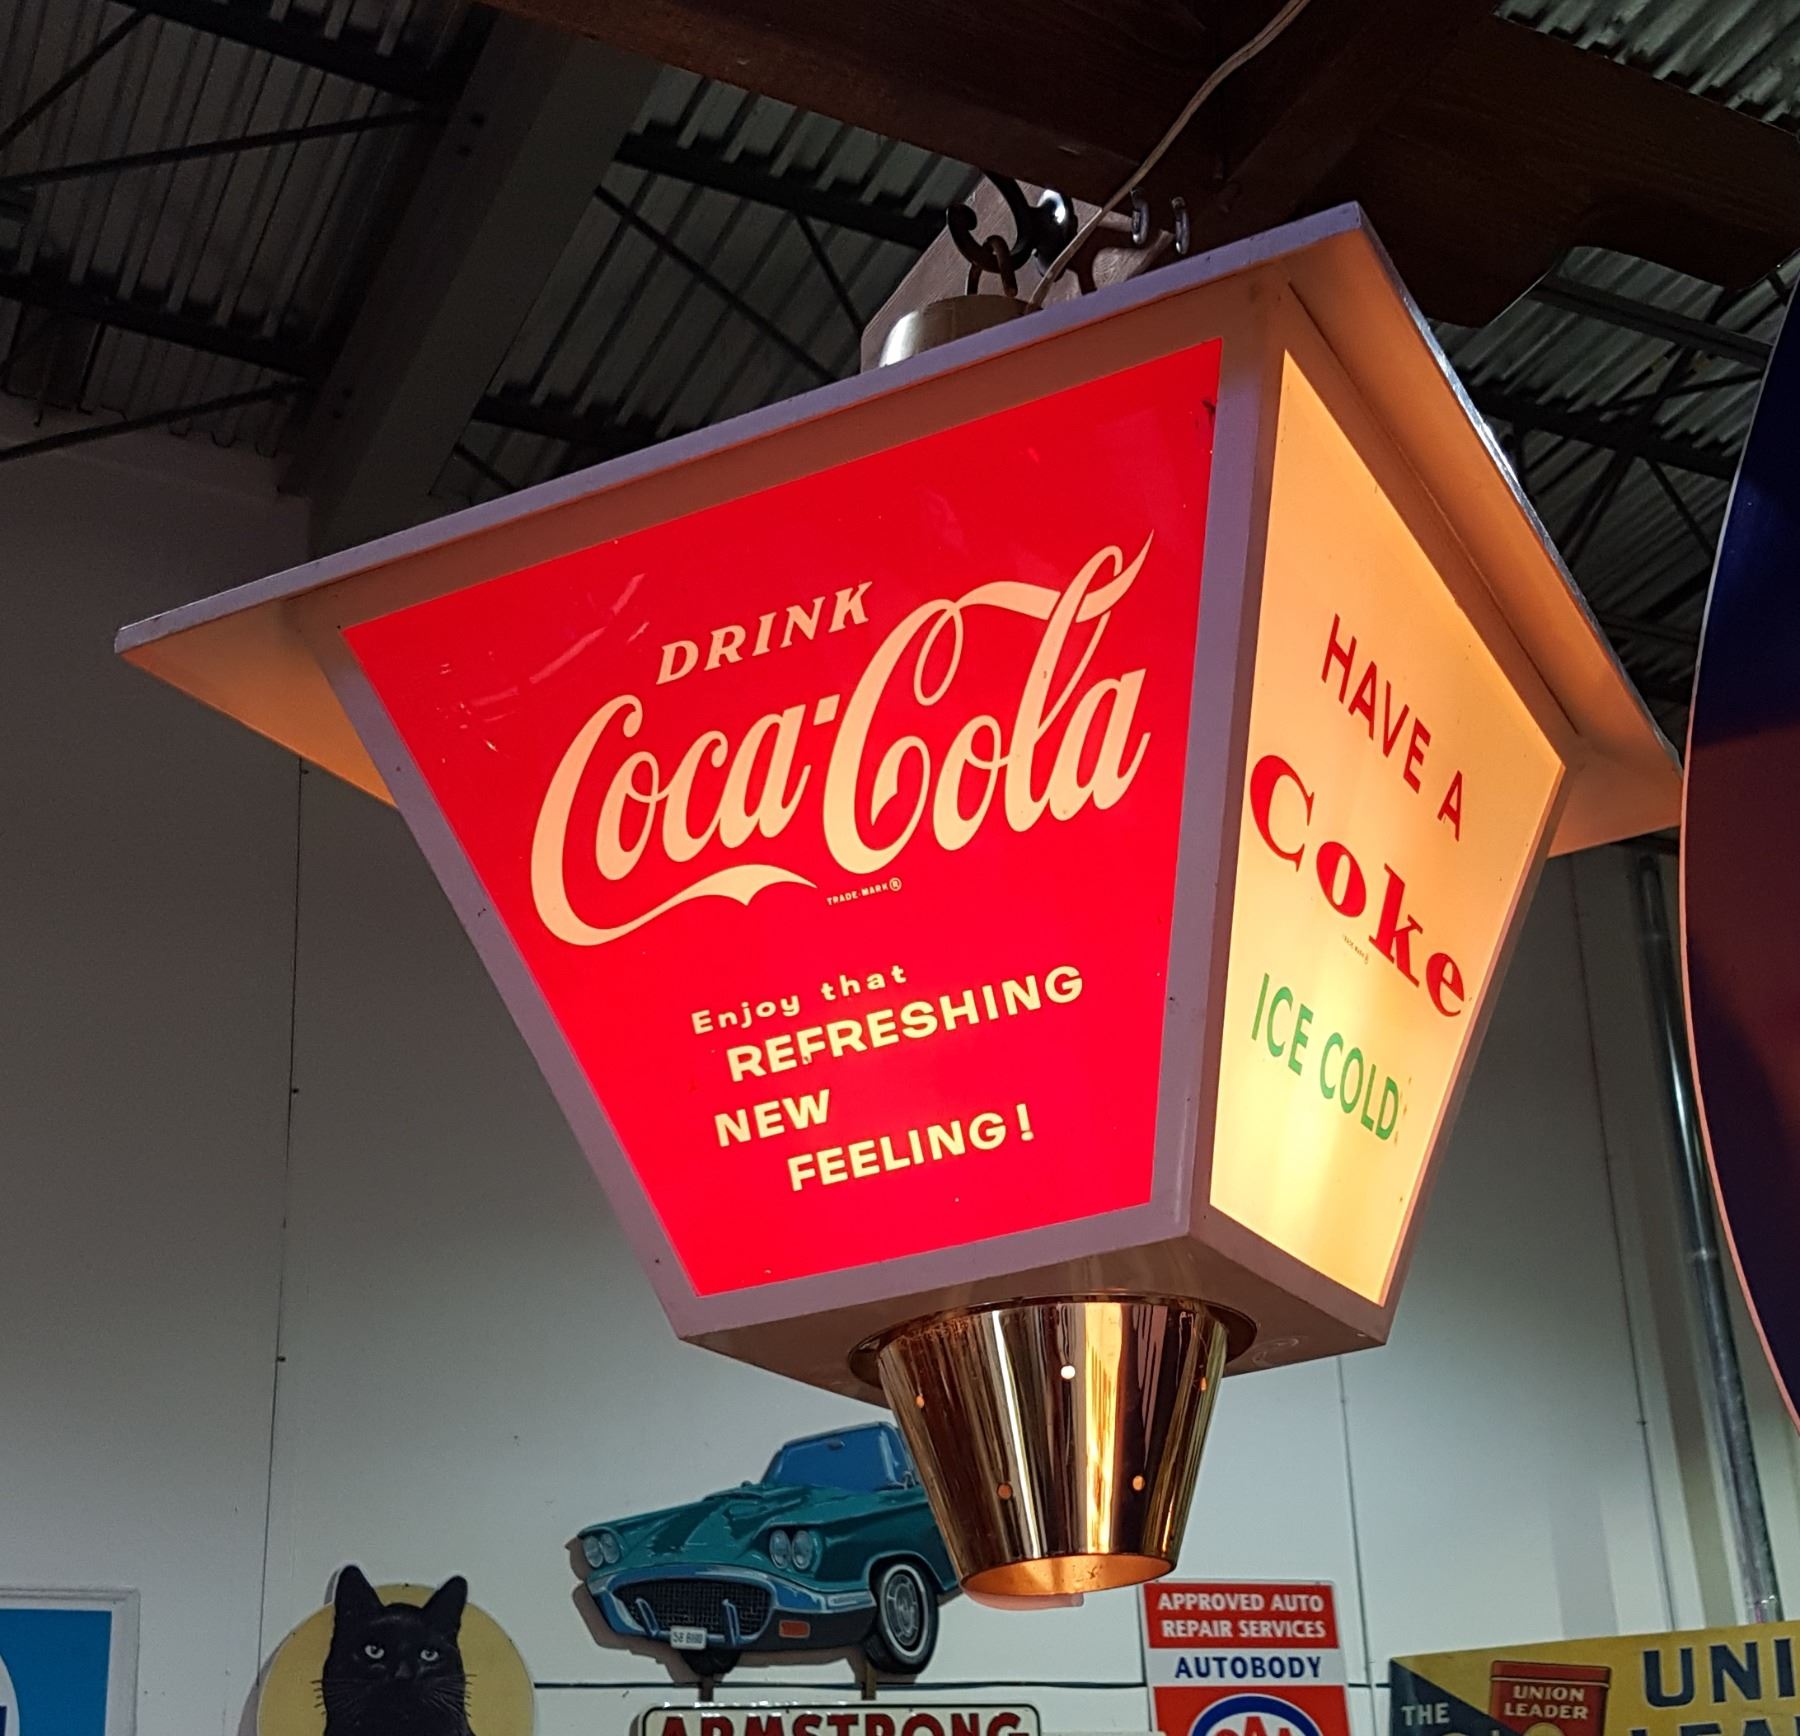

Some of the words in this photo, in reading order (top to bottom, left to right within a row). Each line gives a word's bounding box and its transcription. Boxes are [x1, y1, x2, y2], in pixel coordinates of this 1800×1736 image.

[656, 582, 873, 685] DRINK
[530, 530, 1154, 946] Coca-Cola
[1321, 612, 1431, 795] HAVE
[1437, 770, 1463, 843] A
[1250, 754, 1466, 1017] Coke
[691, 995, 801, 1035] Enjoy
[821, 965, 908, 1001] that
[726, 965, 1083, 1083] REFRESHING
[1251, 972, 1314, 1076] ICE
[1319, 1031, 1400, 1141] COLD
[713, 1088, 831, 1148] NEW
[1157, 1592, 1265, 1612] APPROVED
[1270, 1593, 1325, 1613] AUTO
[1161, 1619, 1234, 1639] REPAIR
[1238, 1620, 1327, 1639] SERVICES
[1174, 1655, 1322, 1679] AUTOBODY
[1512, 1684, 1586, 1702] UNION
[1401, 1702, 1451, 1727] THE
[1504, 1702, 1590, 1720] LEADER
